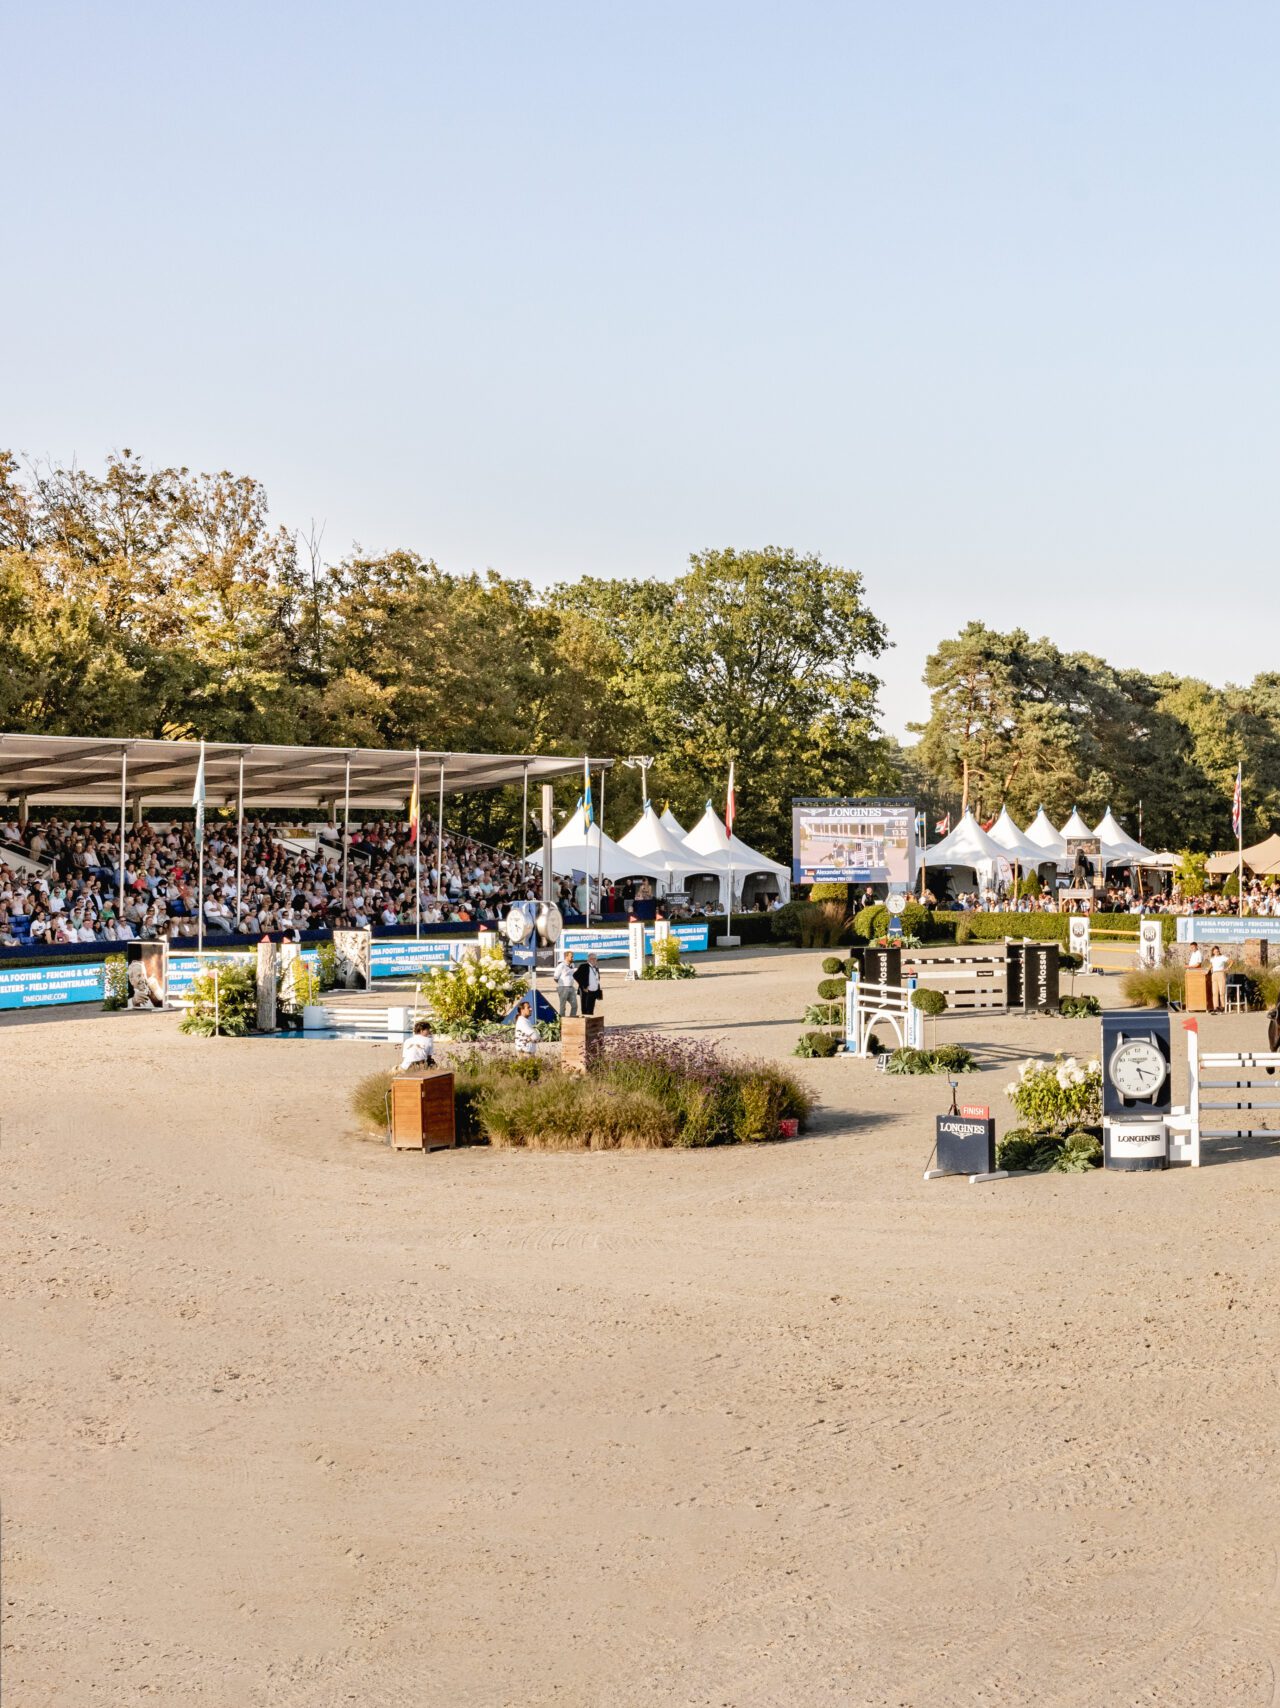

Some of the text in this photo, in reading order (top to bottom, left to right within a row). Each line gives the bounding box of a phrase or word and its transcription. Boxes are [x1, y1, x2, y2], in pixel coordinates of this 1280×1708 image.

[829, 808, 881, 816] LONGINES
[10, 972, 42, 982] FOOTING
[46, 970, 76, 980] FENCING
[1038, 951, 1046, 1005] Van Mossel
[29, 982, 48, 992] FIELD
[49, 978, 98, 990] MAINTENANCE
[964, 1106, 984, 1116] FINISH
[940, 1122, 984, 1134] LONGINES
